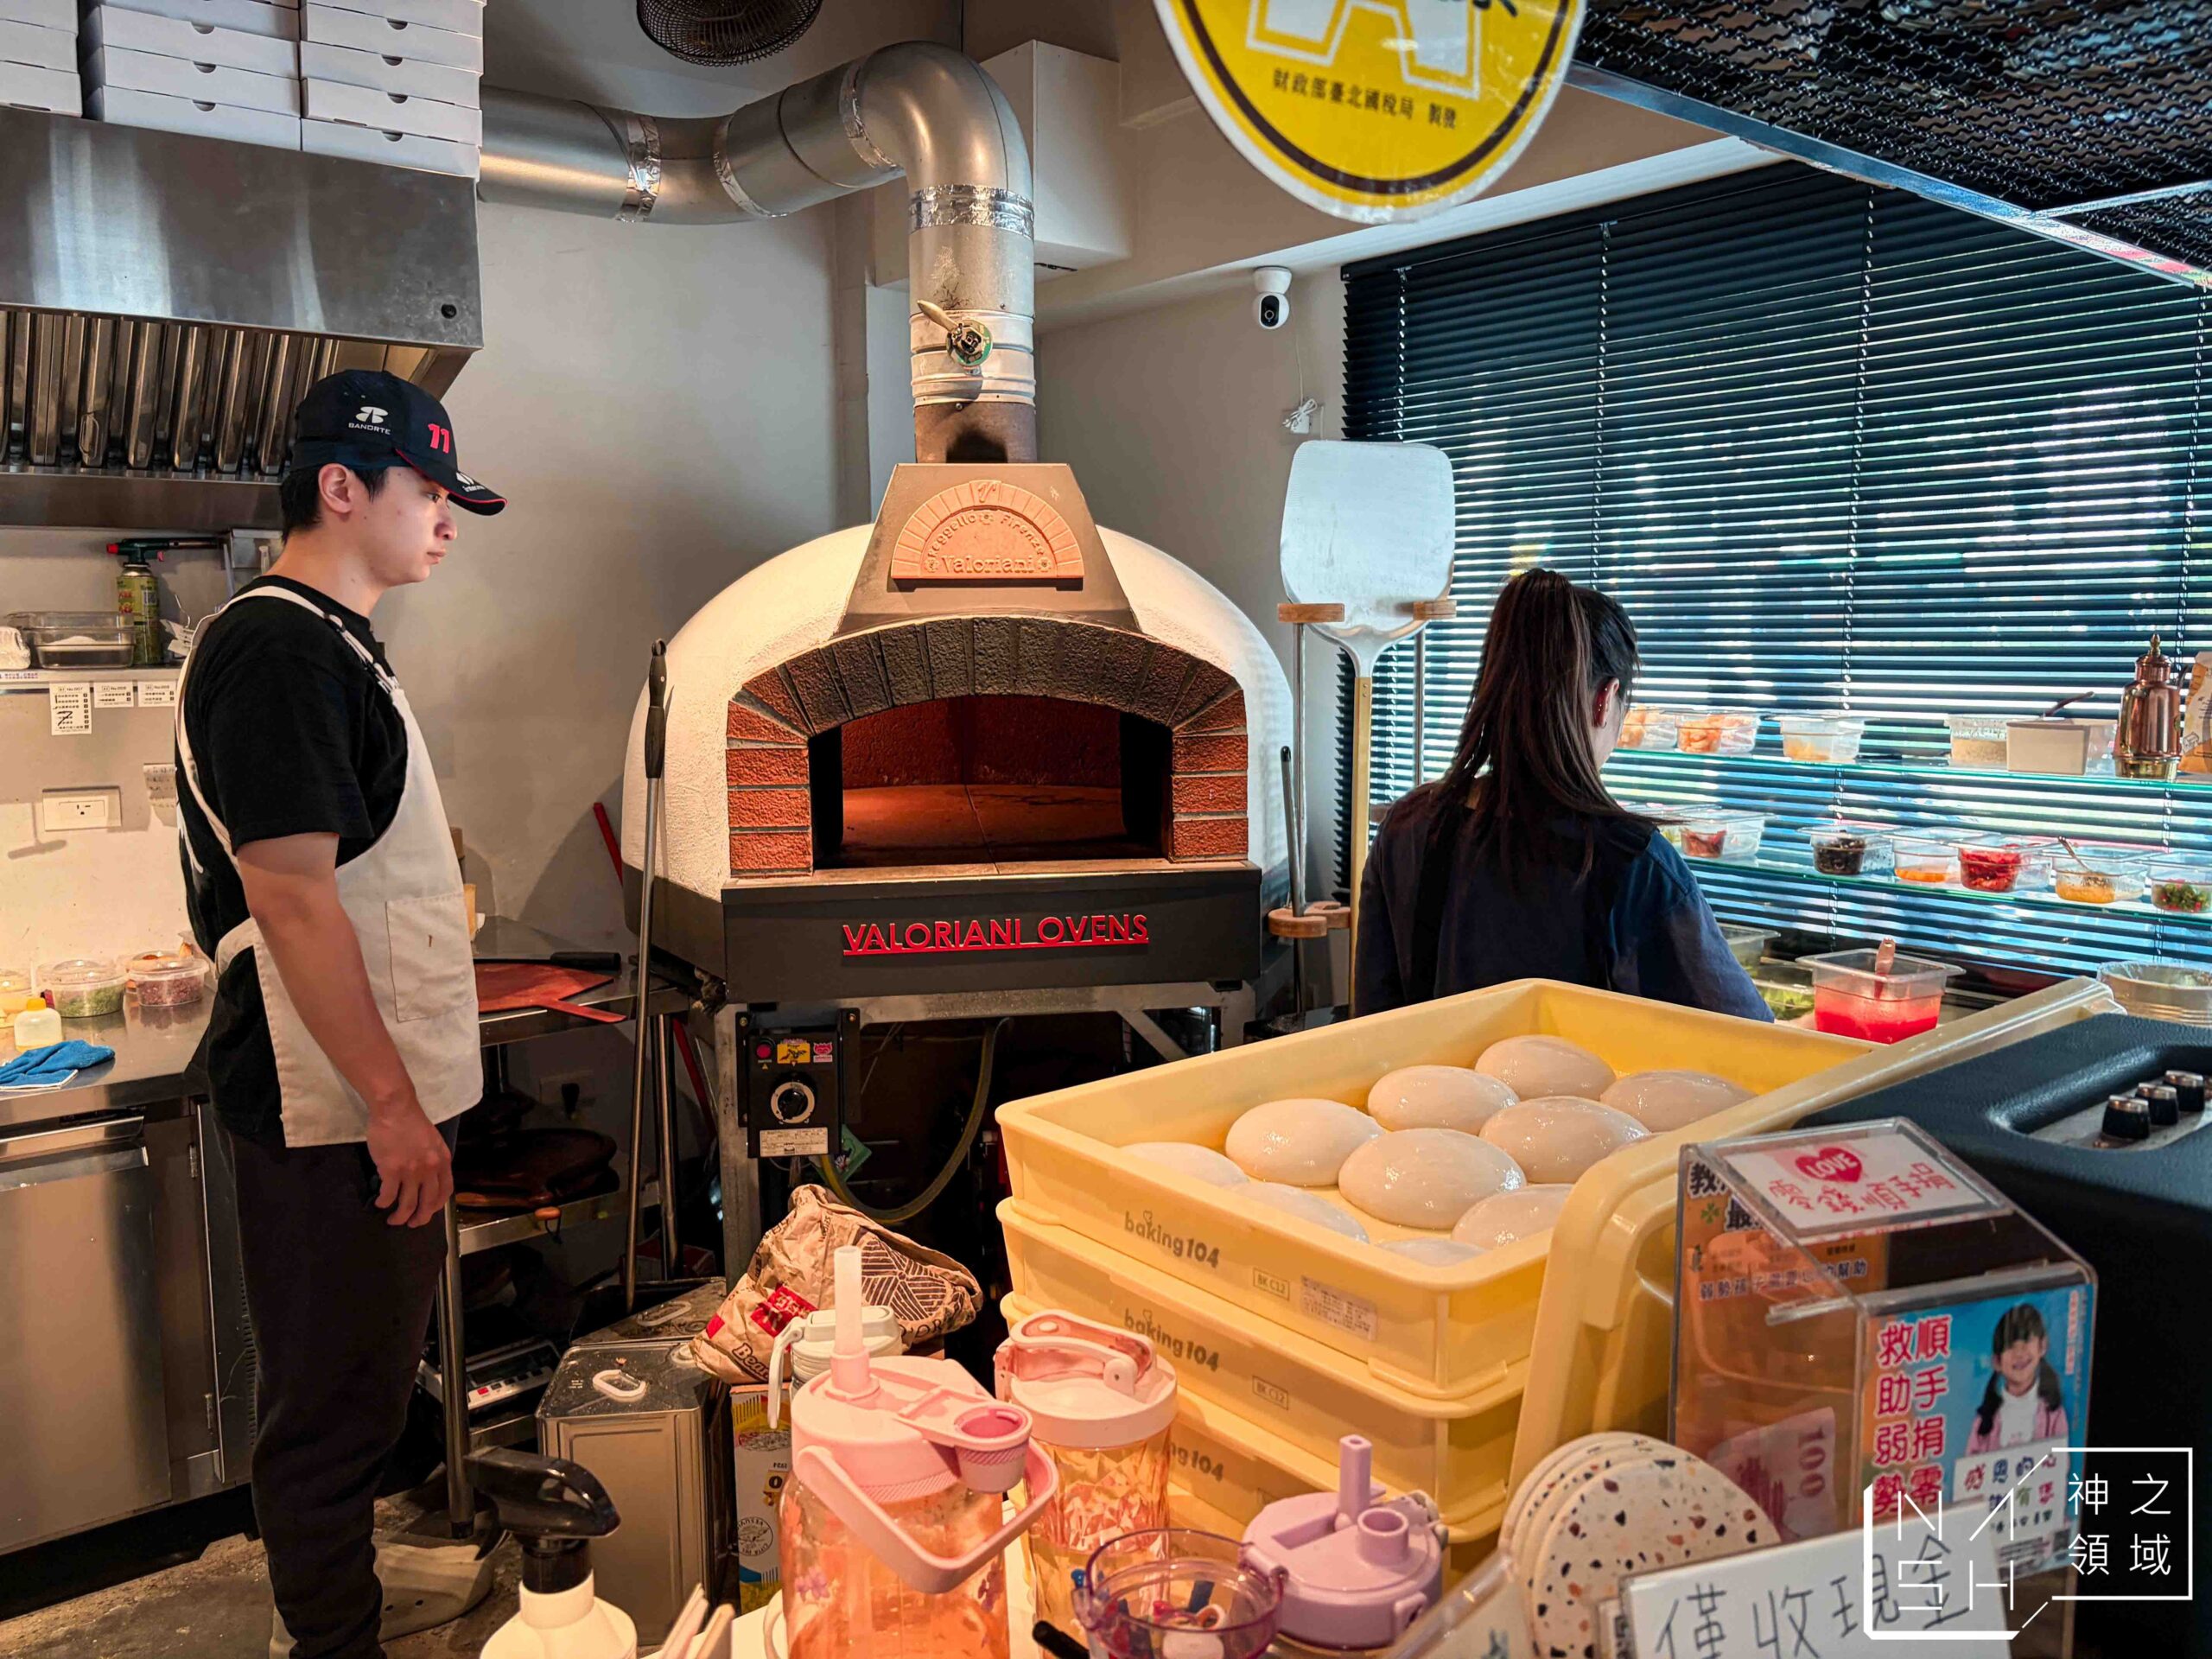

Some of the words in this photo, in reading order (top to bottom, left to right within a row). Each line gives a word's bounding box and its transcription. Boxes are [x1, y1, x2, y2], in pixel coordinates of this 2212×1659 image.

[348, 423, 391, 435] BANORTE
[428, 423, 450, 454] 11
[927, 511, 976, 558] Reggello
[1000, 513, 1046, 556] Firenze
[943, 554, 1035, 574] Valoriani
[842, 918, 1021, 951] VALORIANI
[1038, 914, 1149, 944] OVENS
[1807, 1153, 1858, 1178] LOVE
[1769, 1162, 1958, 1213] 零錢順手捐
[1124, 1211, 1220, 1268] baking104
[1124, 1309, 1220, 1372] baking104
[1170, 1442, 1224, 1482] ng104
[1798, 1427, 1827, 1497] 100
[737, 1518, 764, 1529] VESUVI
[1656, 1533, 1971, 1659] 僅收現金
